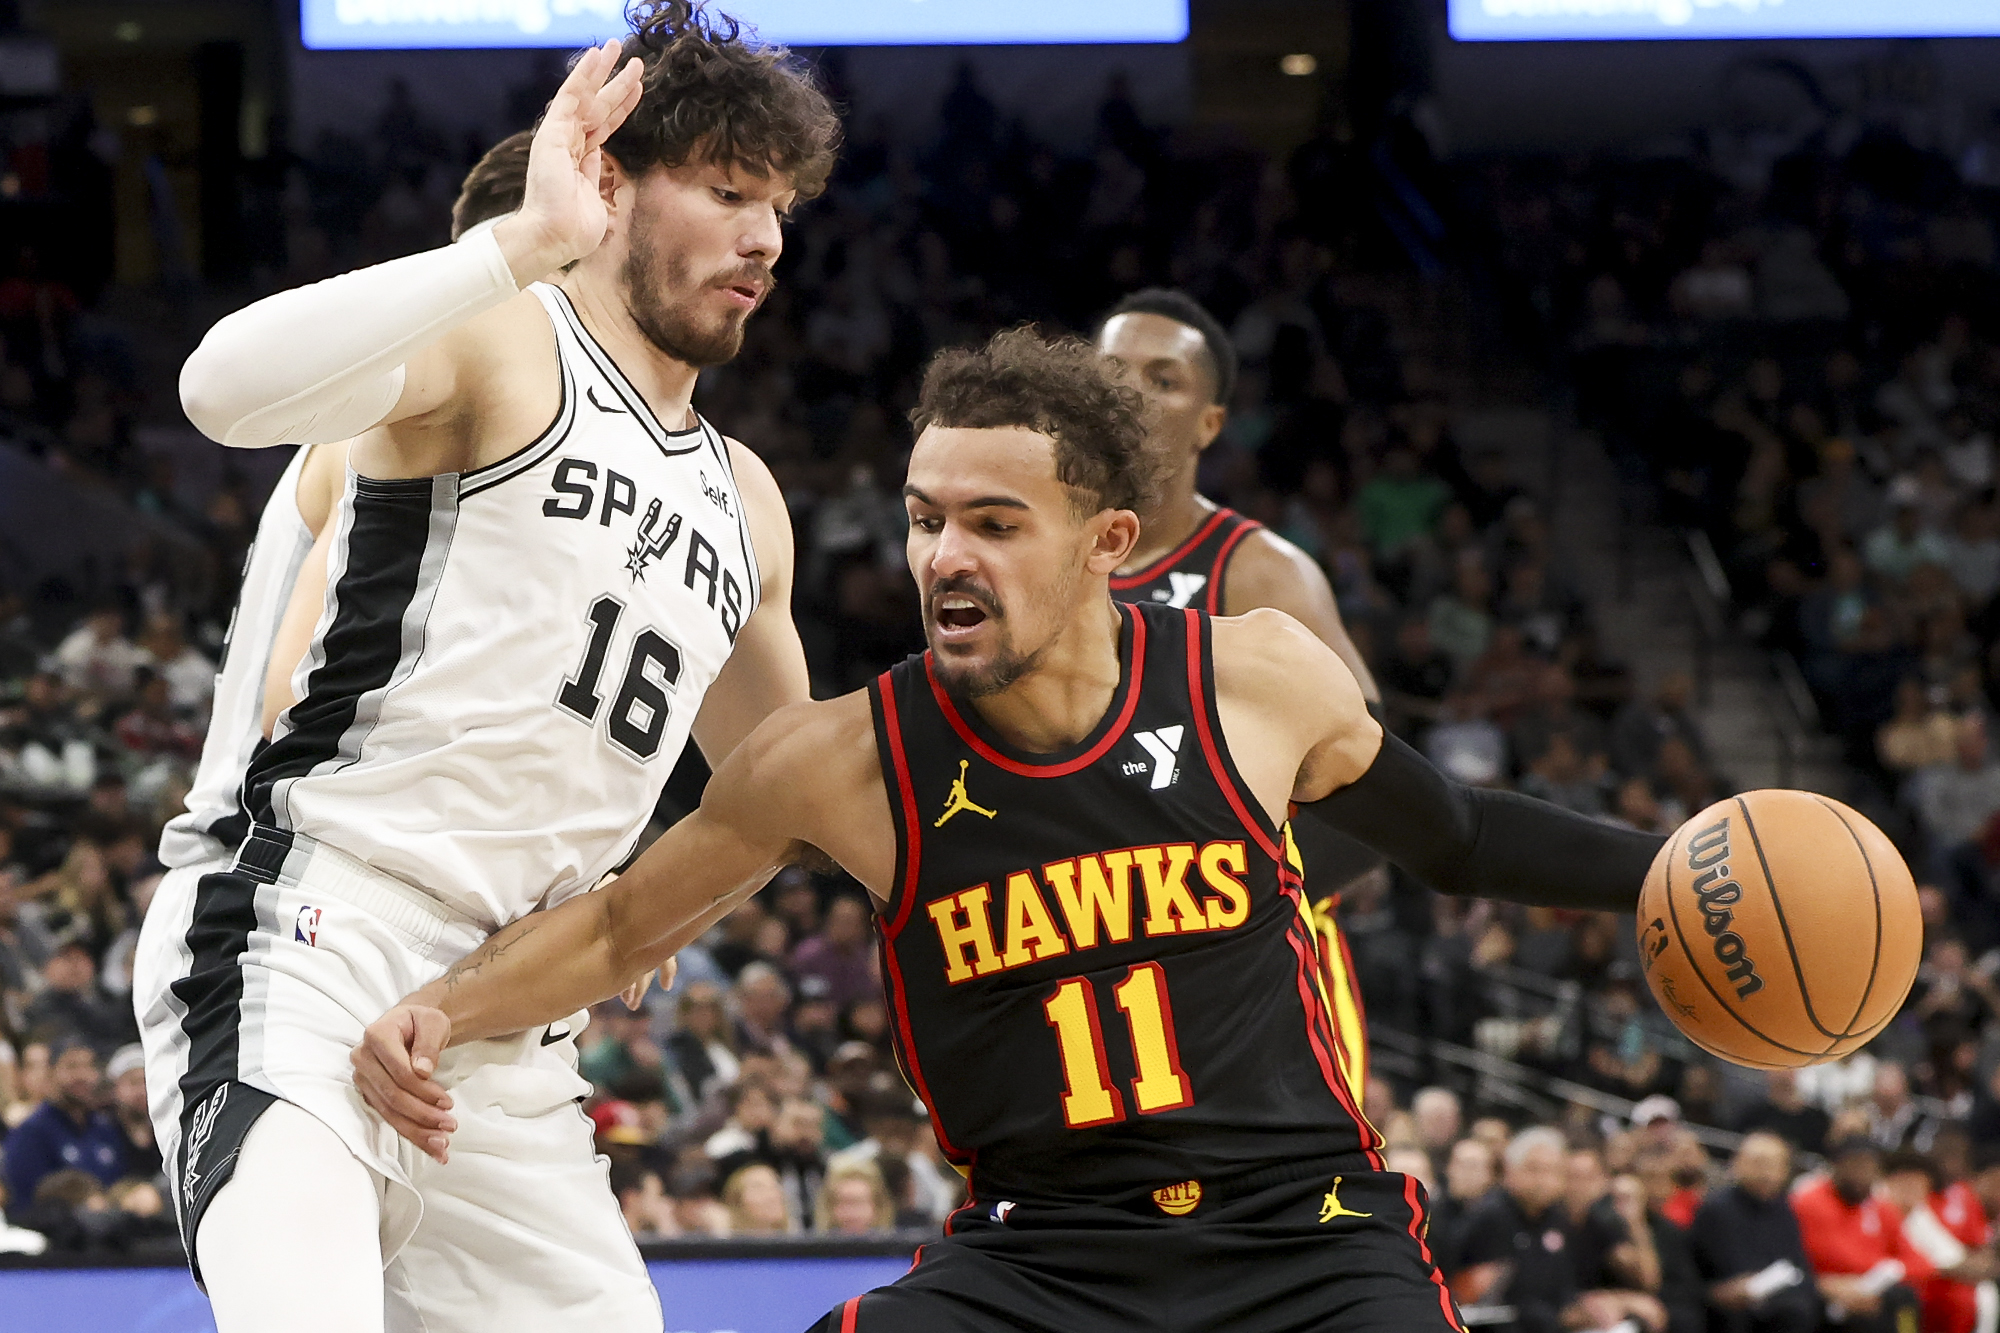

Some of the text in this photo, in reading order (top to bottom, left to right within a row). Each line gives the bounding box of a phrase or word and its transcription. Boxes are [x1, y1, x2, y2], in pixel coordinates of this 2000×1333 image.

[552, 591, 685, 765] 16
[1122, 761, 1148, 776] the
[925, 840, 1252, 986] HAWKS
[1686, 815, 1766, 1003] Wilson
[1042, 960, 1195, 1129] 11
